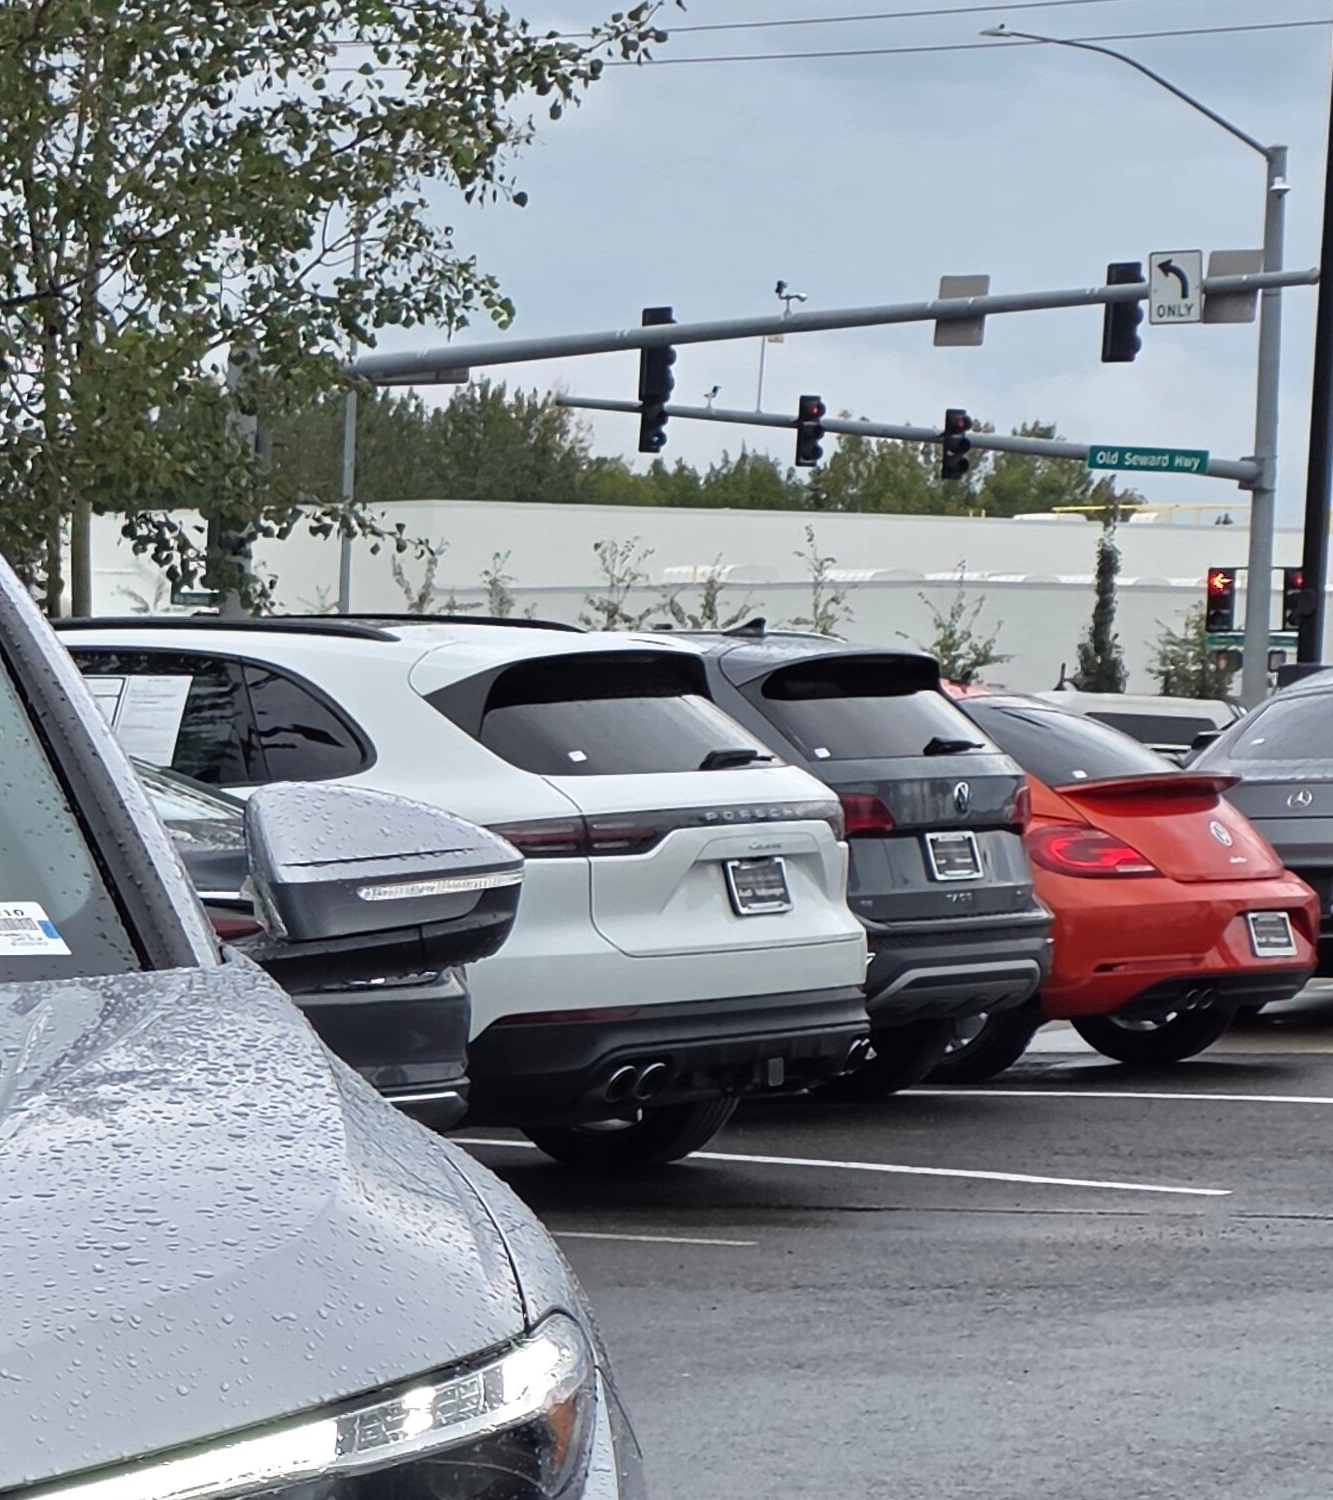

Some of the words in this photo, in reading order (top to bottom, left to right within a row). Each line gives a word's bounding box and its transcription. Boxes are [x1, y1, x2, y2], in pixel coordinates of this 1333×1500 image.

[1156, 303, 1194, 318] ONLY
[1096, 450, 1119, 465] Old
[1124, 452, 1170, 467] Seward
[1174, 455, 1201, 471] Hwy
